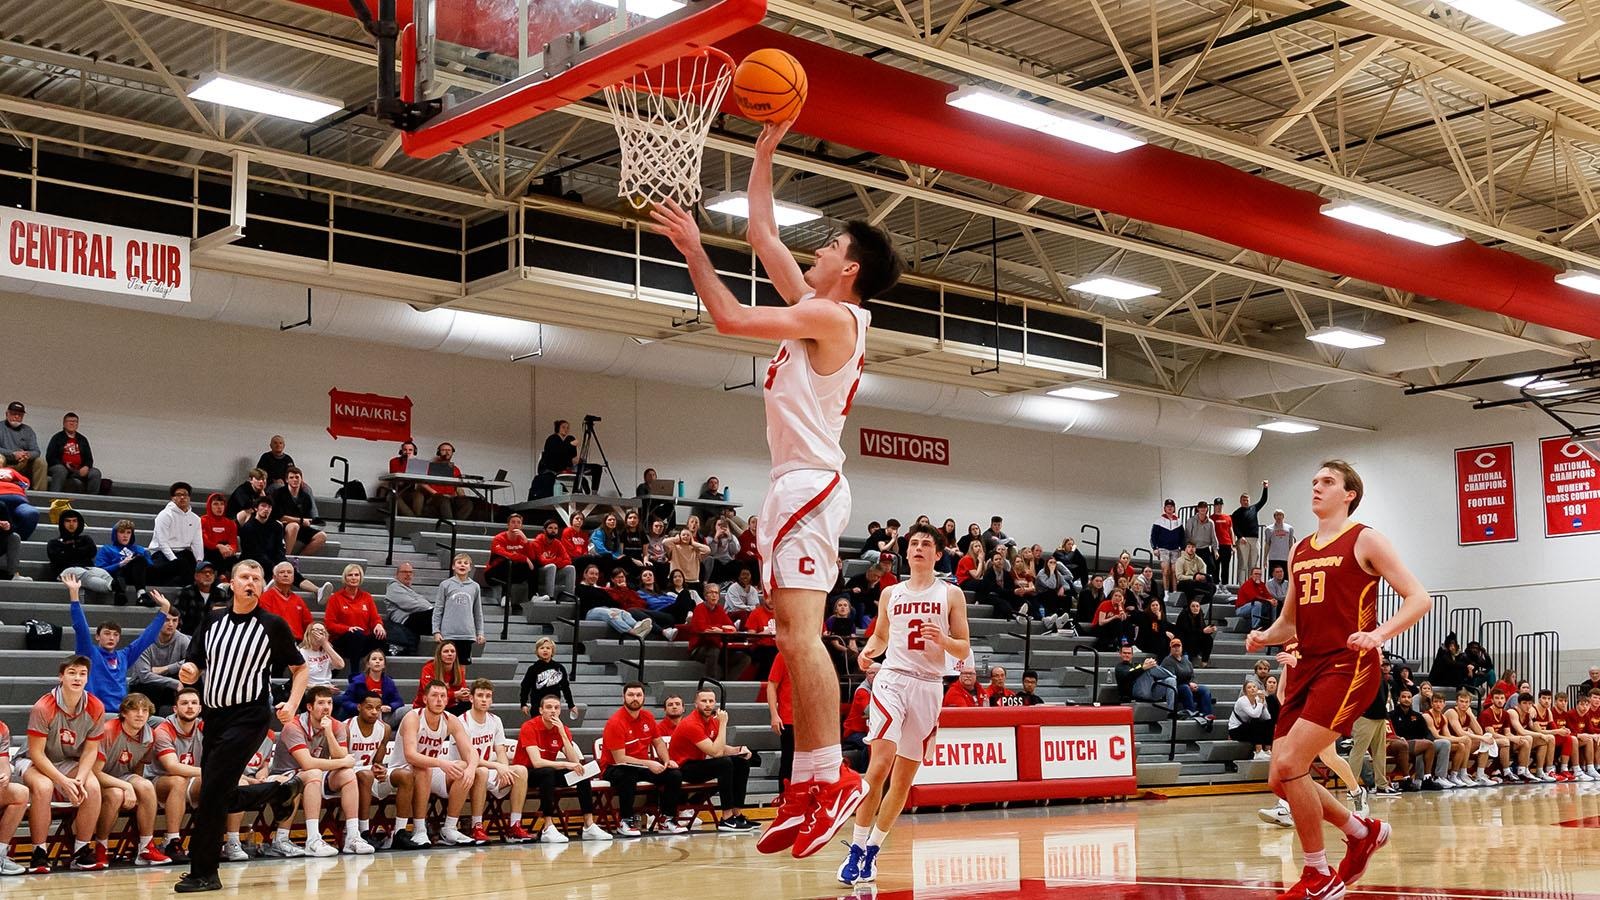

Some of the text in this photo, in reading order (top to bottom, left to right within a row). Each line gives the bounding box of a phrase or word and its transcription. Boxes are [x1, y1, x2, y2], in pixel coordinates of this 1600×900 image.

[9, 219, 181, 289] CENTRAL CLUB
[334, 403, 407, 422] KNIA/KRLS
[863, 432, 946, 461] VISITORS
[1554, 460, 1591, 472] NATIONAL
[1468, 471, 1502, 483] NATIONAL
[1550, 468, 1596, 482] CHAMPIONS
[1464, 479, 1507, 492] CHAMPIONS
[1557, 482, 1590, 494] WOMEN'S
[1467, 496, 1505, 508] FOOTBALL
[1546, 494, 1569, 503] CROSS
[1563, 503, 1587, 517] 1981
[1476, 513, 1498, 525] 1974
[1299, 570, 1326, 606] 33
[893, 602, 941, 616] DUTCH
[908, 618, 925, 651] 2
[922, 742, 1007, 767] ENTRAL
[1044, 735, 1126, 762] DUTCH C
